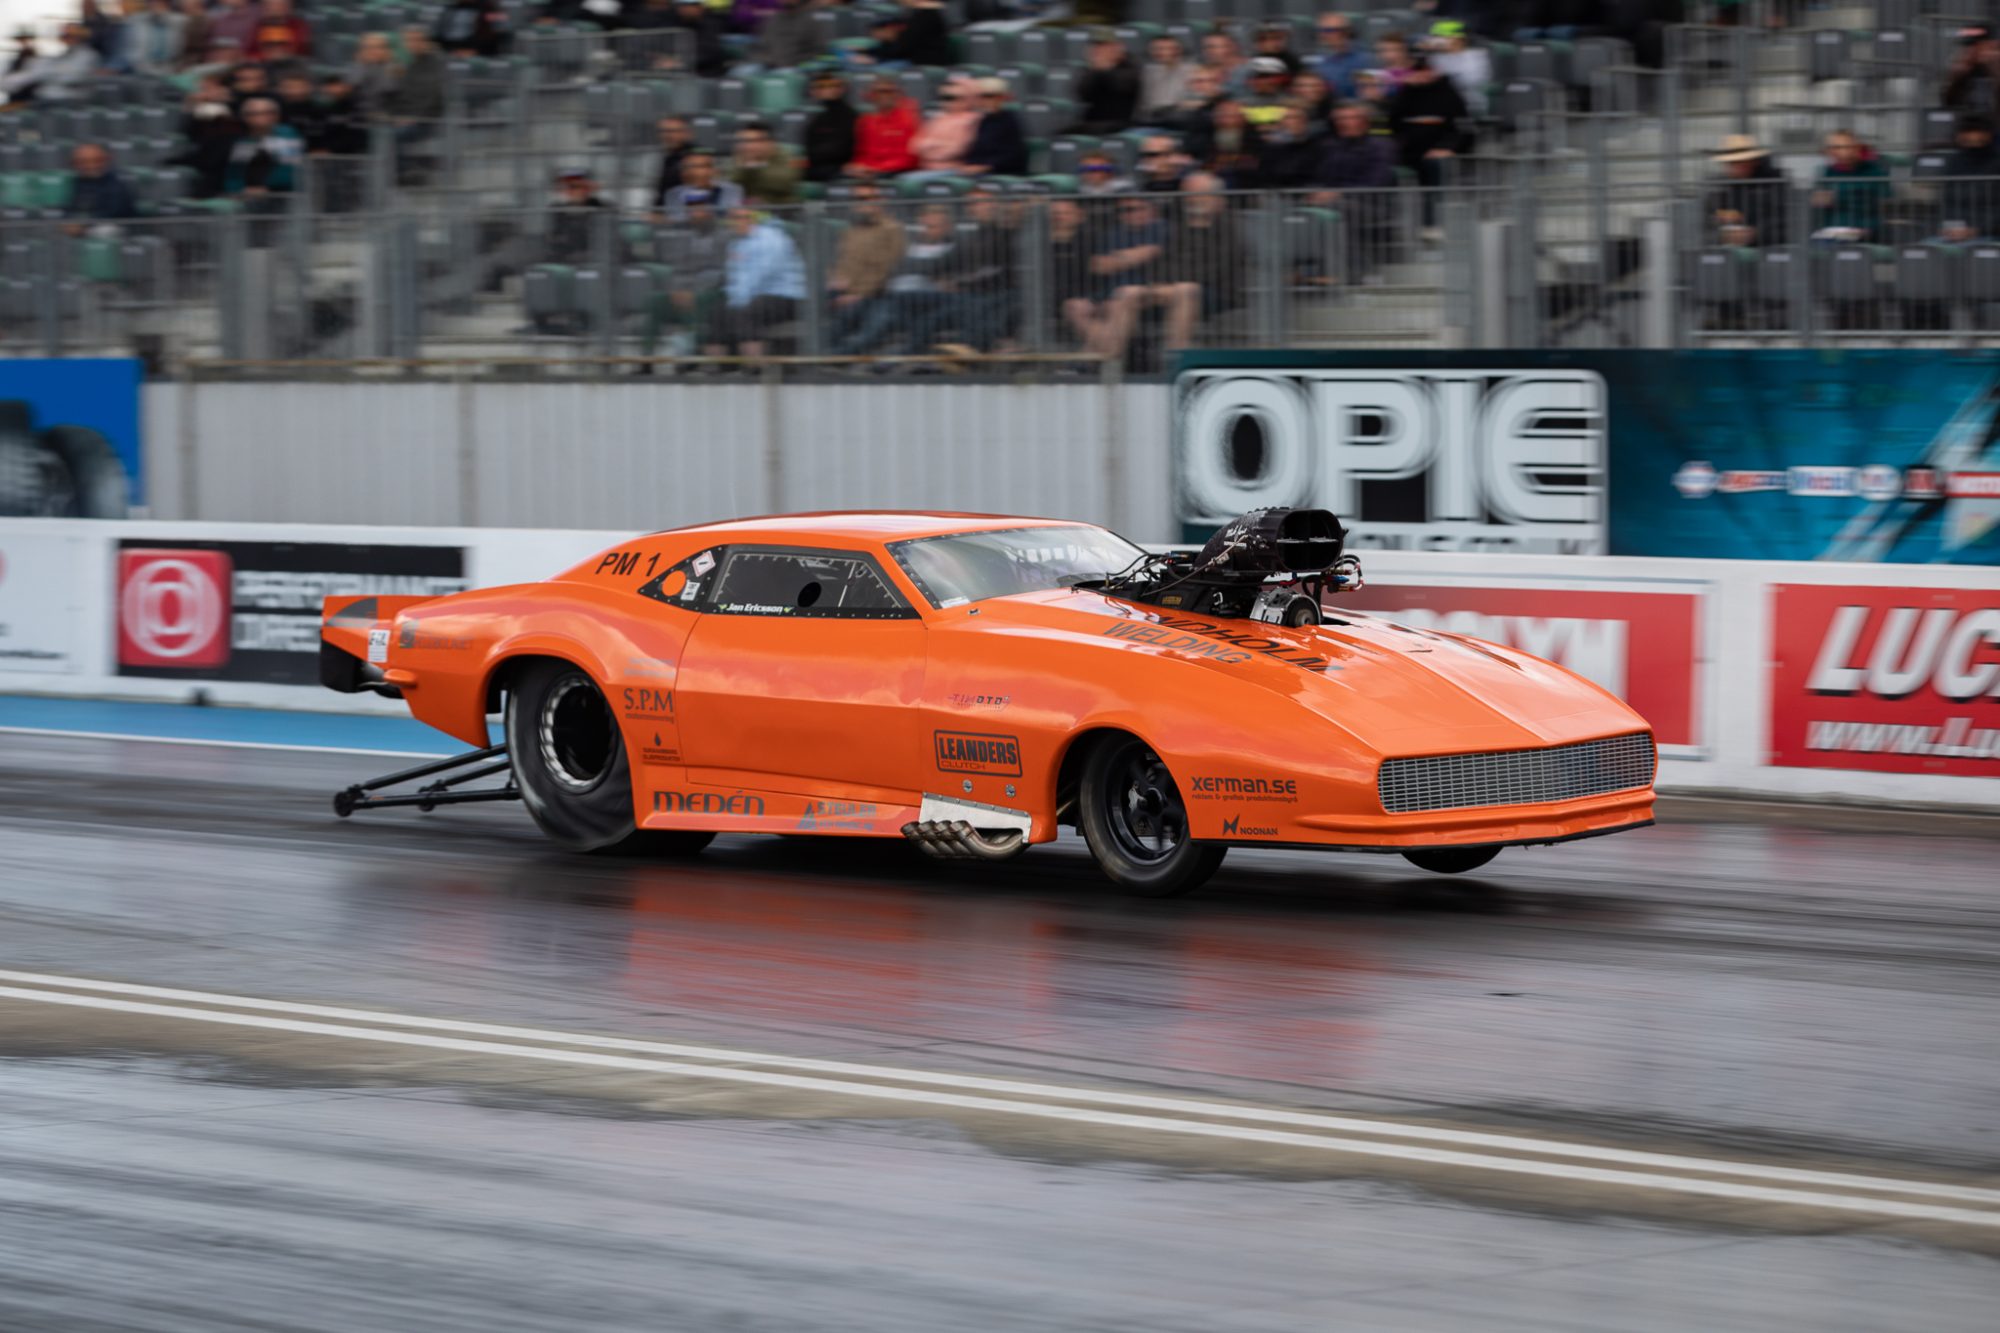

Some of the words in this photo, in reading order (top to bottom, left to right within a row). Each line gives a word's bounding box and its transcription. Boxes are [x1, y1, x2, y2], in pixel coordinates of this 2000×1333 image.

[1178, 372, 1600, 526] OPIE
[595, 552, 641, 575] PM
[646, 552, 662, 576] 1
[1103, 621, 1253, 664] WELDING
[938, 736, 1017, 765] LEANDERS
[940, 760, 986, 770] CLUTCH
[1191, 776, 1297, 794] xerman.se
[1240, 827, 1279, 836] NOONAN
